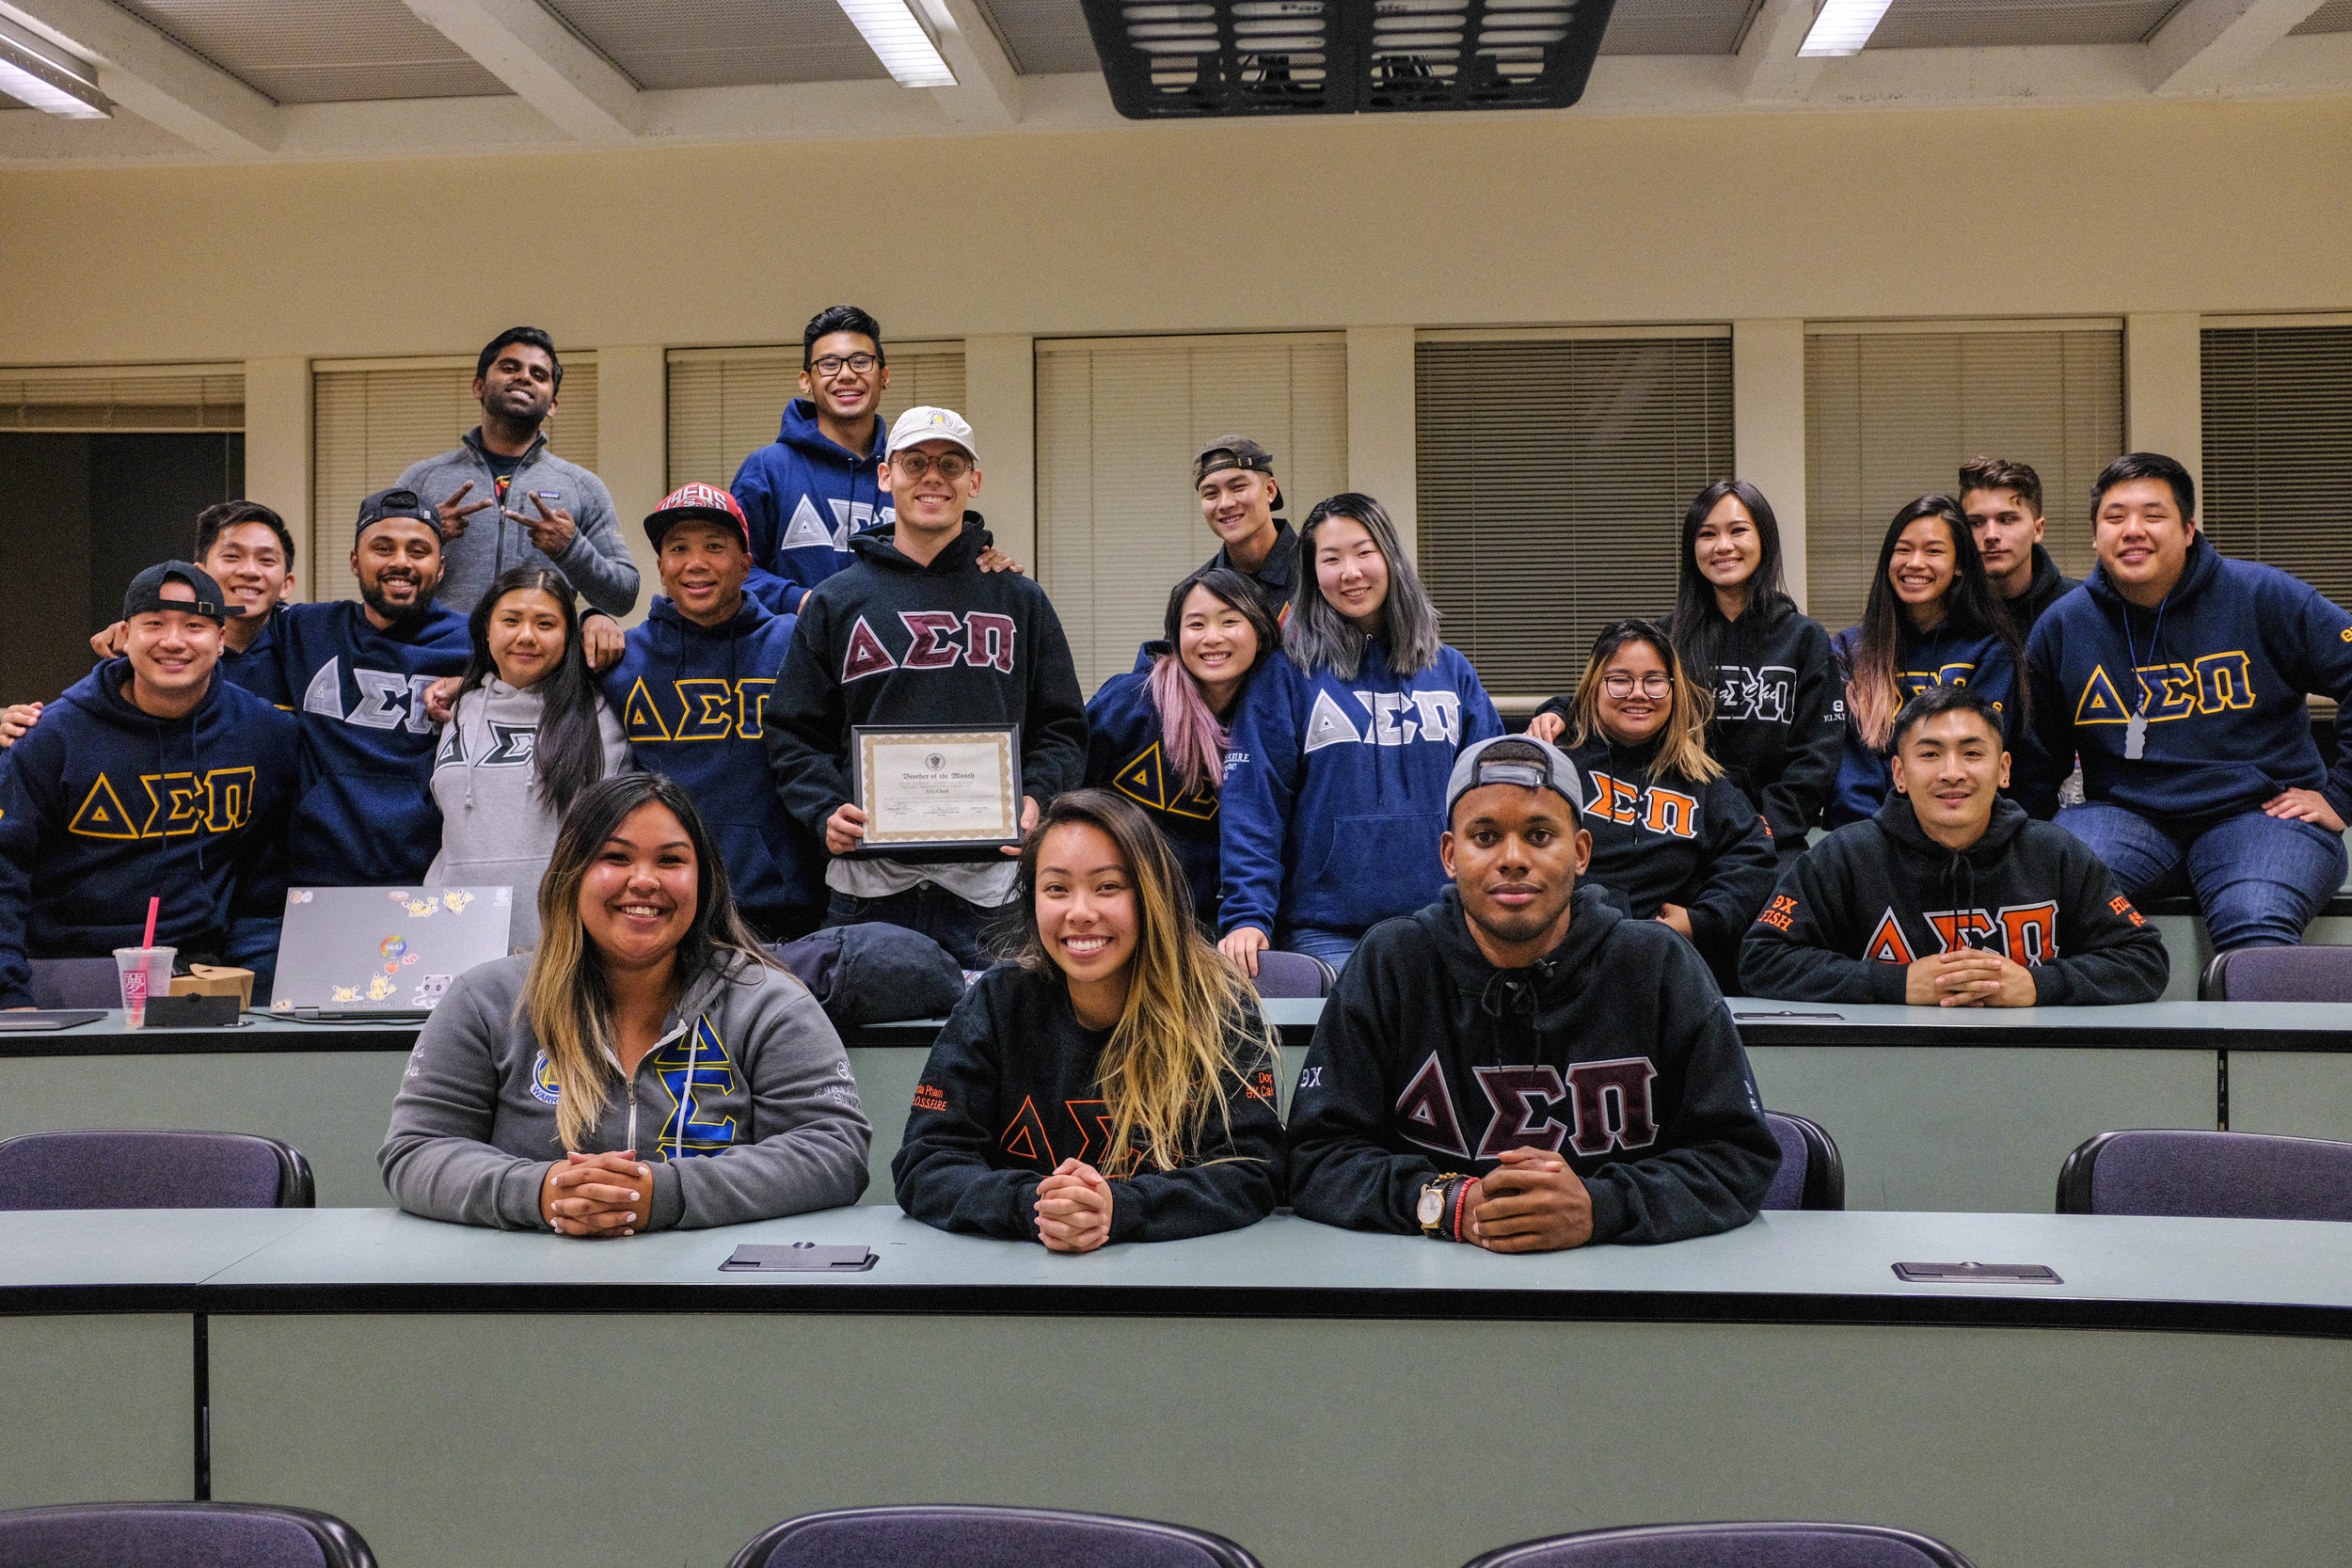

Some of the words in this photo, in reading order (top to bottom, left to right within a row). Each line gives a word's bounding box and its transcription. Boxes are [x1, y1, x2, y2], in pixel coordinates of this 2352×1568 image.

[781, 493, 896, 552] ΔΣ
[433, 720, 539, 772] ΔΣ
[1582, 770, 1699, 839] ΣΠ
[532, 1085, 559, 1104] WARR
